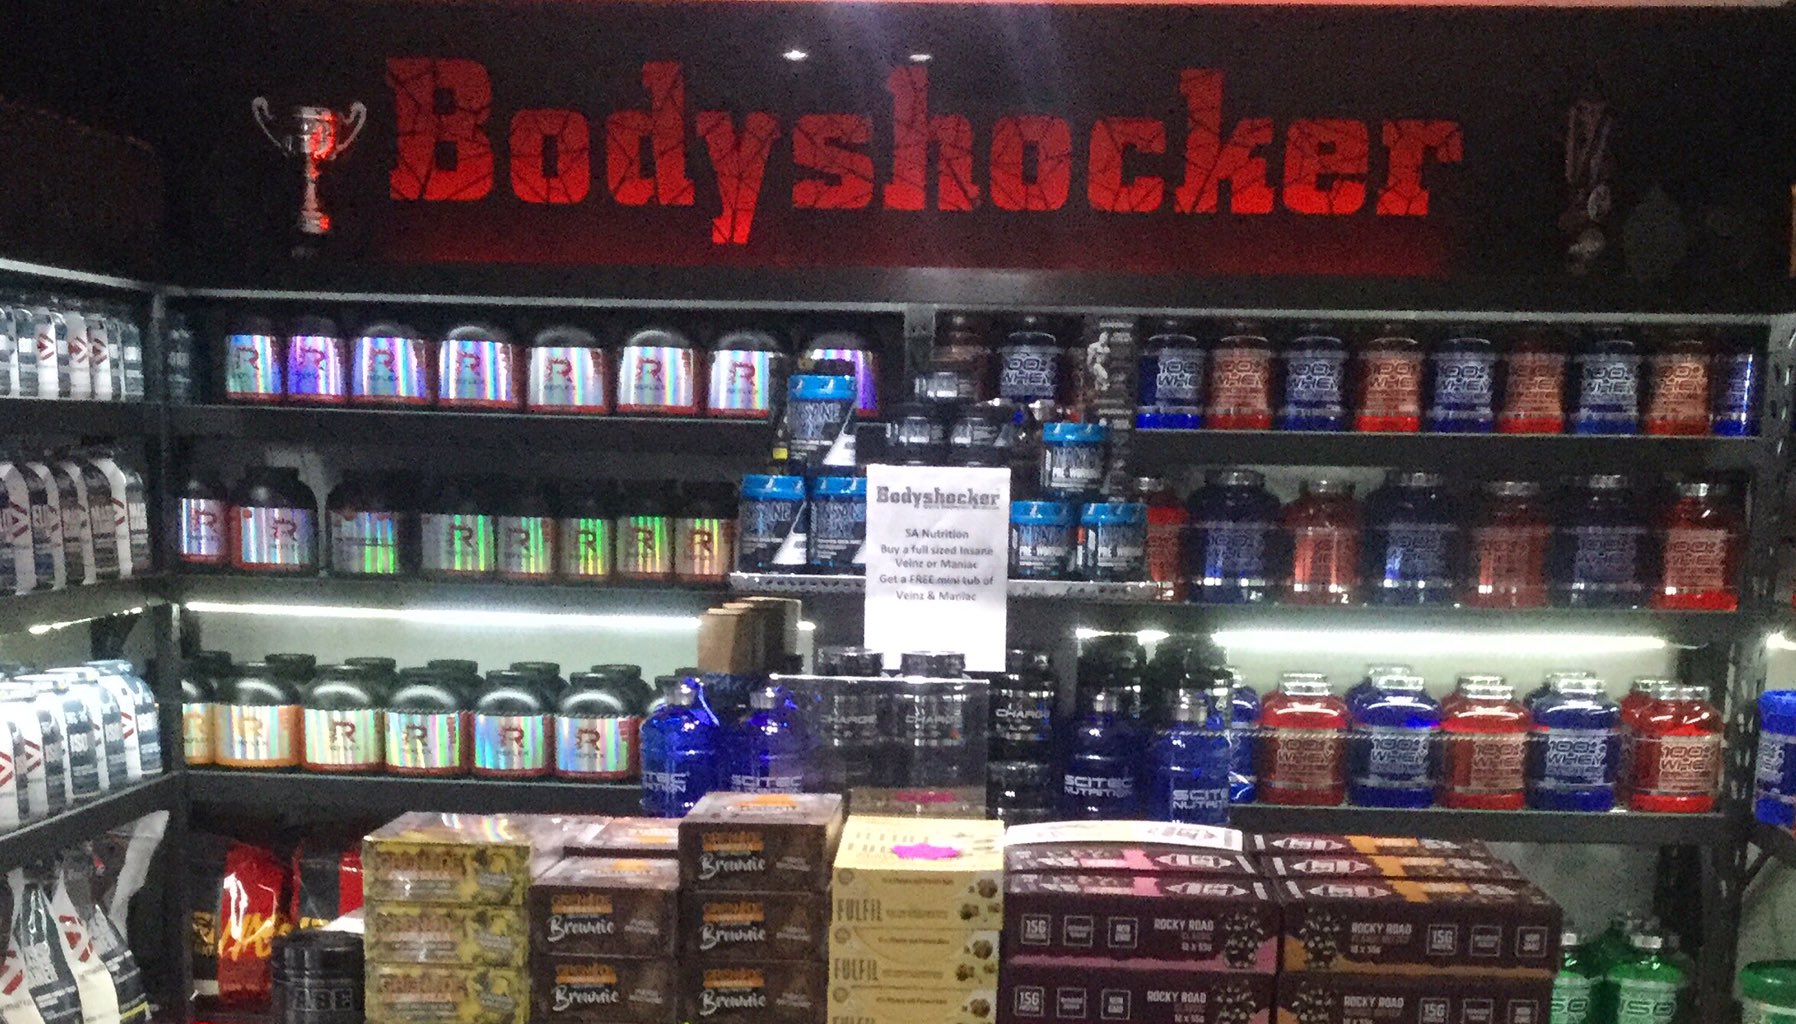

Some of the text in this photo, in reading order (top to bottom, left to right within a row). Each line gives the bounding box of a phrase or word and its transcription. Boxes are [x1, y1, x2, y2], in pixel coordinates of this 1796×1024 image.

[387, 57, 1463, 245] Bodyshocker
[1157, 373, 1200, 388] WHE
[876, 486, 1000, 508] Bodyshocker
[905, 529, 969, 539] SA Nutrition
[881, 545, 899, 556] Buy
[911, 545, 929, 555] full
[931, 546, 957, 556] sized
[960, 546, 994, 556] Insane
[940, 559, 978, 569] Maniac
[879, 575, 898, 584] Get
[909, 575, 934, 585] FREE
[962, 576, 981, 586] tub
[982, 576, 994, 586] of
[928, 591, 936, 600] &
[939, 591, 977, 601] Maniac
[1549, 741, 1606, 754] 100%
[1370, 751, 1429, 764] WHEY
[1549, 754, 1606, 768] WHEY
[1065, 774, 1133, 788] SCITEC
[1172, 789, 1229, 801] SCITE
[700, 853, 767, 880] Brownie
[837, 898, 882, 922] FULFIL
[546, 914, 615, 943] Brownie
[1154, 917, 1215, 932] ROCKY ROAD
[1351, 921, 1413, 936] ROCKY ROAD
[700, 924, 767, 950] Brownie
[834, 957, 879, 982] FULFIL
[551, 984, 619, 1012] Brownie
[700, 989, 767, 1017] Brownie
[1019, 991, 1040, 1006] 15G
[1146, 990, 1207, 1004] ROCKY ROAD
[1343, 995, 1405, 1010] ROCKY ROAD
[1550, 998, 1590, 1013] SO
